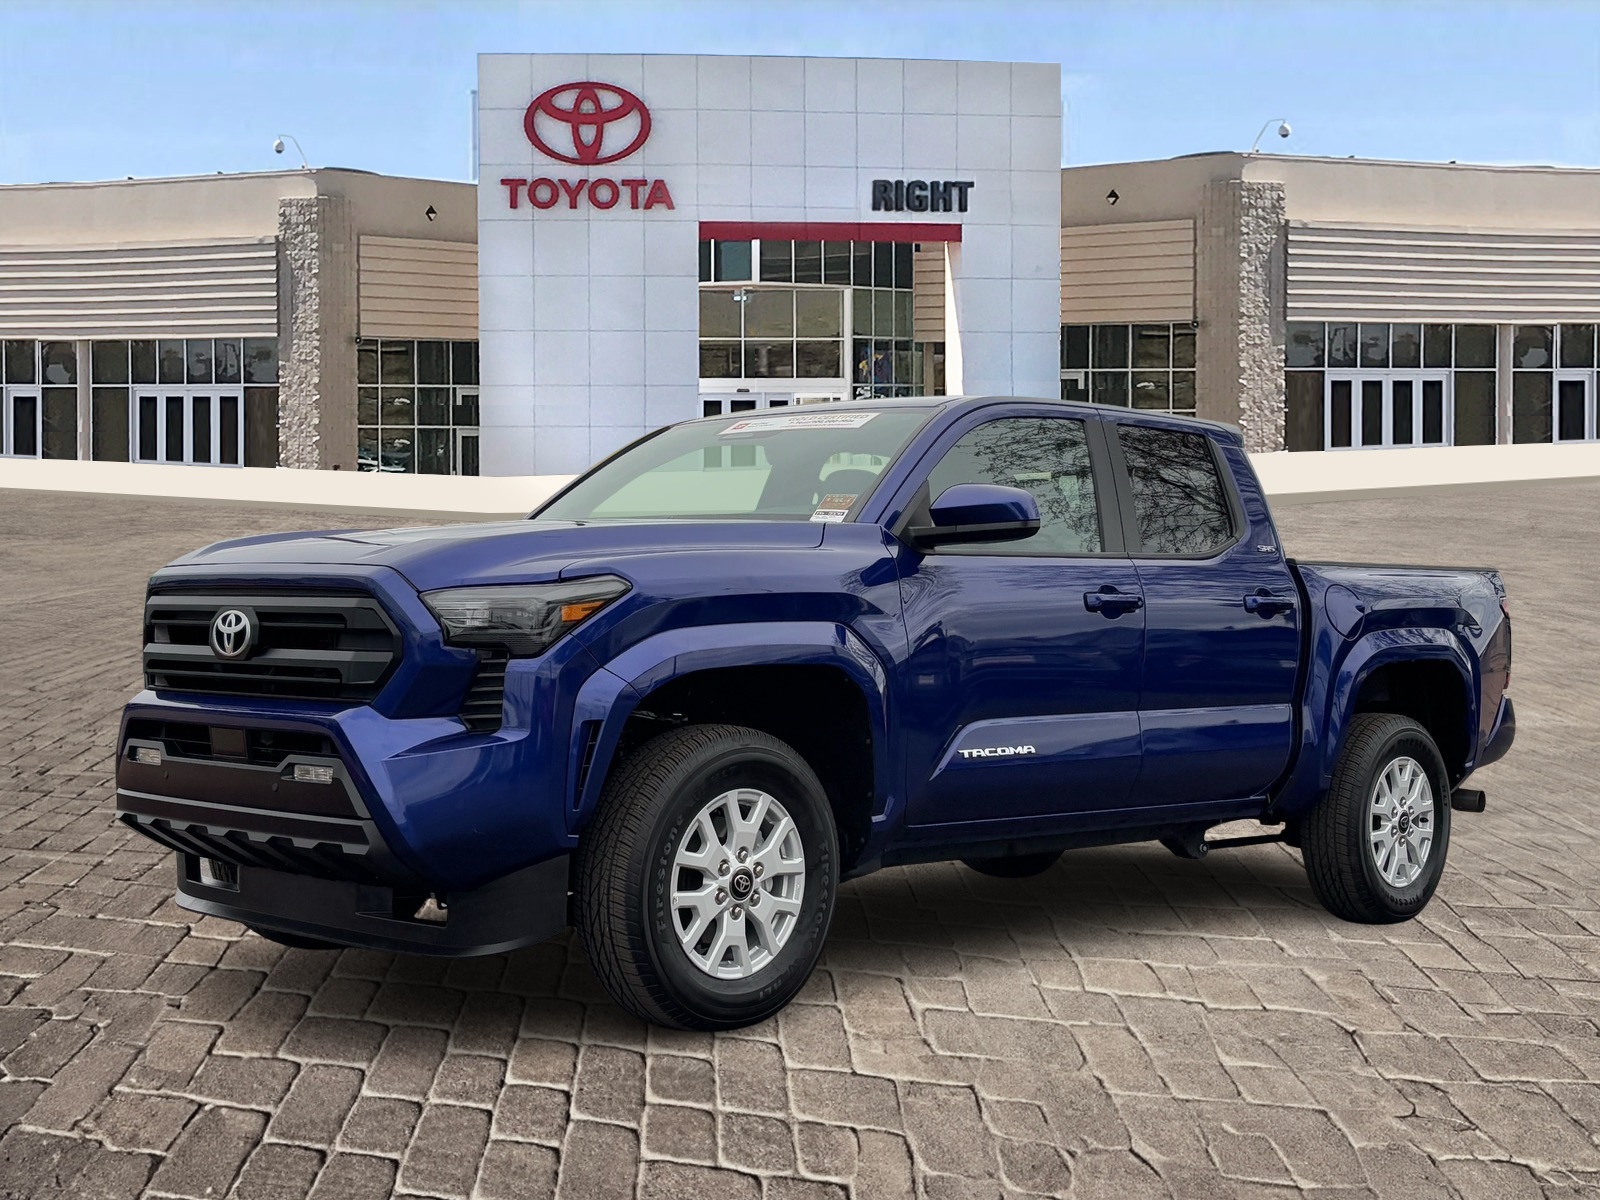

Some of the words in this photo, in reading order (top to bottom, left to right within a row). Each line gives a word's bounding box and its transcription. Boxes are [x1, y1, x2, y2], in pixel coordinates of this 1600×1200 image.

[500, 179, 676, 210] TOYOTA
[871, 179, 975, 213] RIGHT
[957, 745, 1036, 759] TACOMA
[655, 814, 685, 936] Firestone
